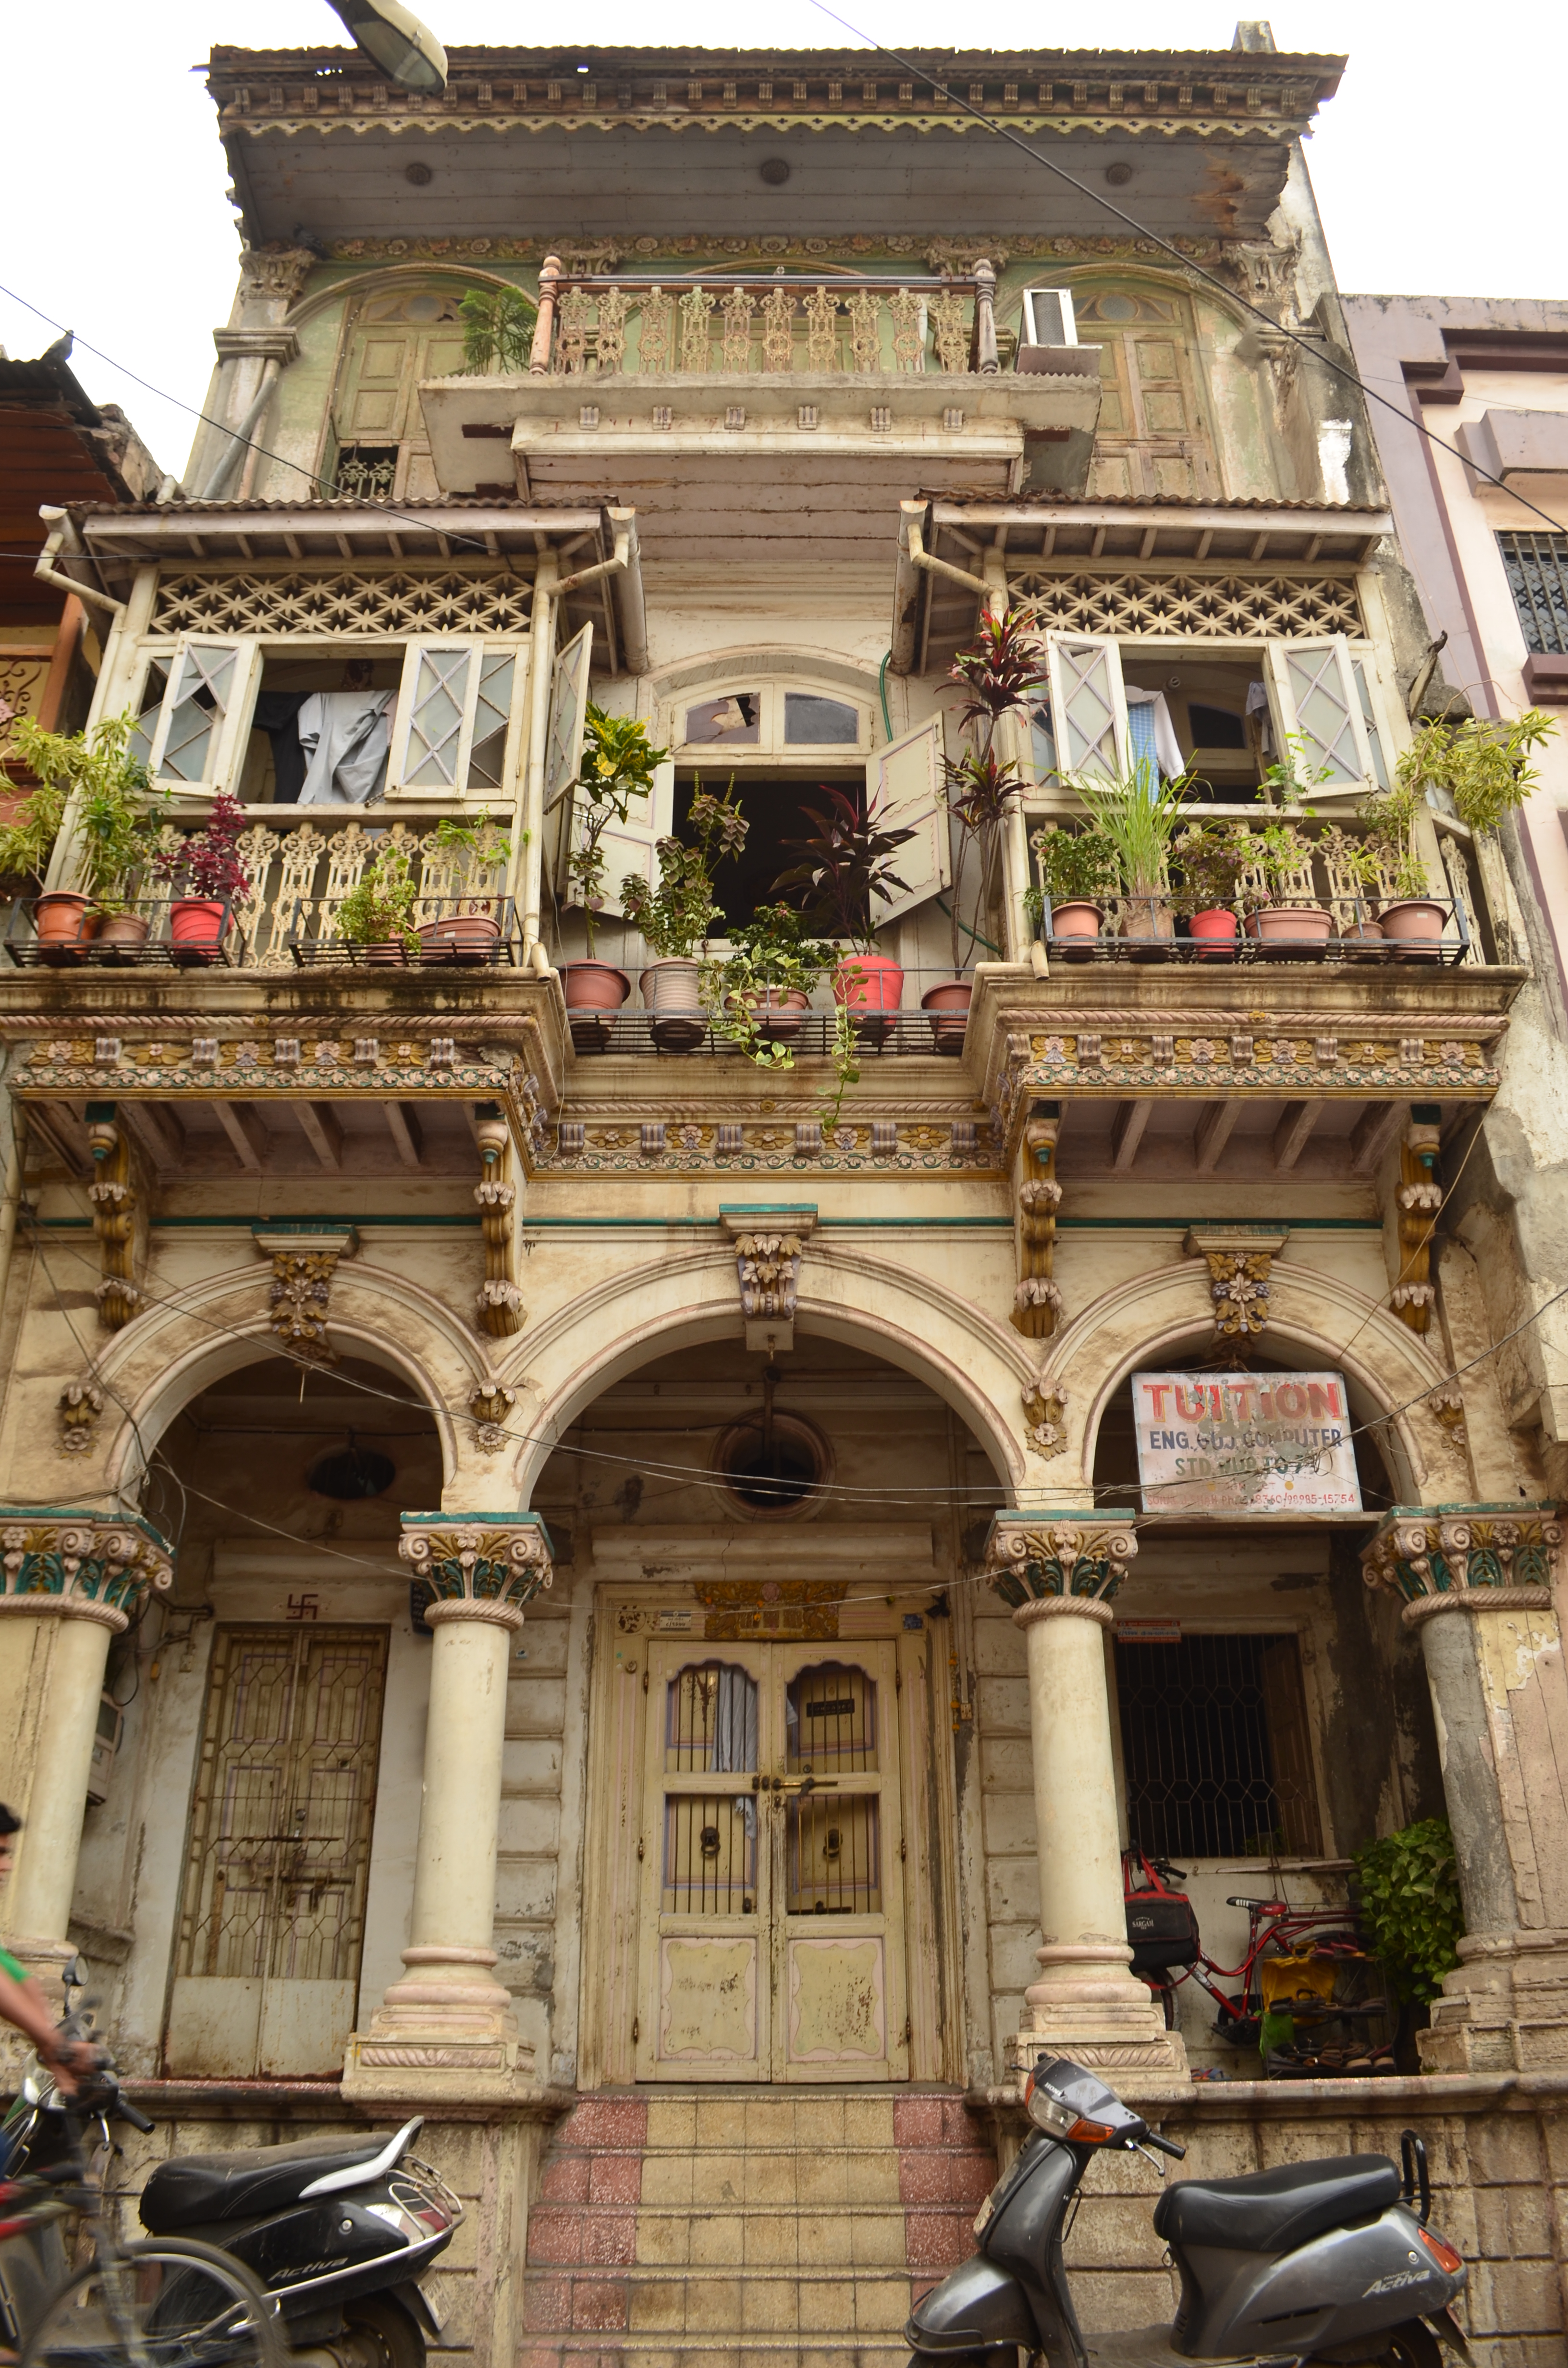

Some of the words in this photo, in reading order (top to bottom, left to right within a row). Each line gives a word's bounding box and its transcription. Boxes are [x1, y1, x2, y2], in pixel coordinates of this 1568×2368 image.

[1143, 1383, 1343, 1421] TUITION
[1242, 1429, 1343, 1448] COMPUTER
[1132, 1919, 1154, 1927] SARGAM
[267, 2256, 349, 2282] Activa
[1361, 2269, 1430, 2298] Activa
